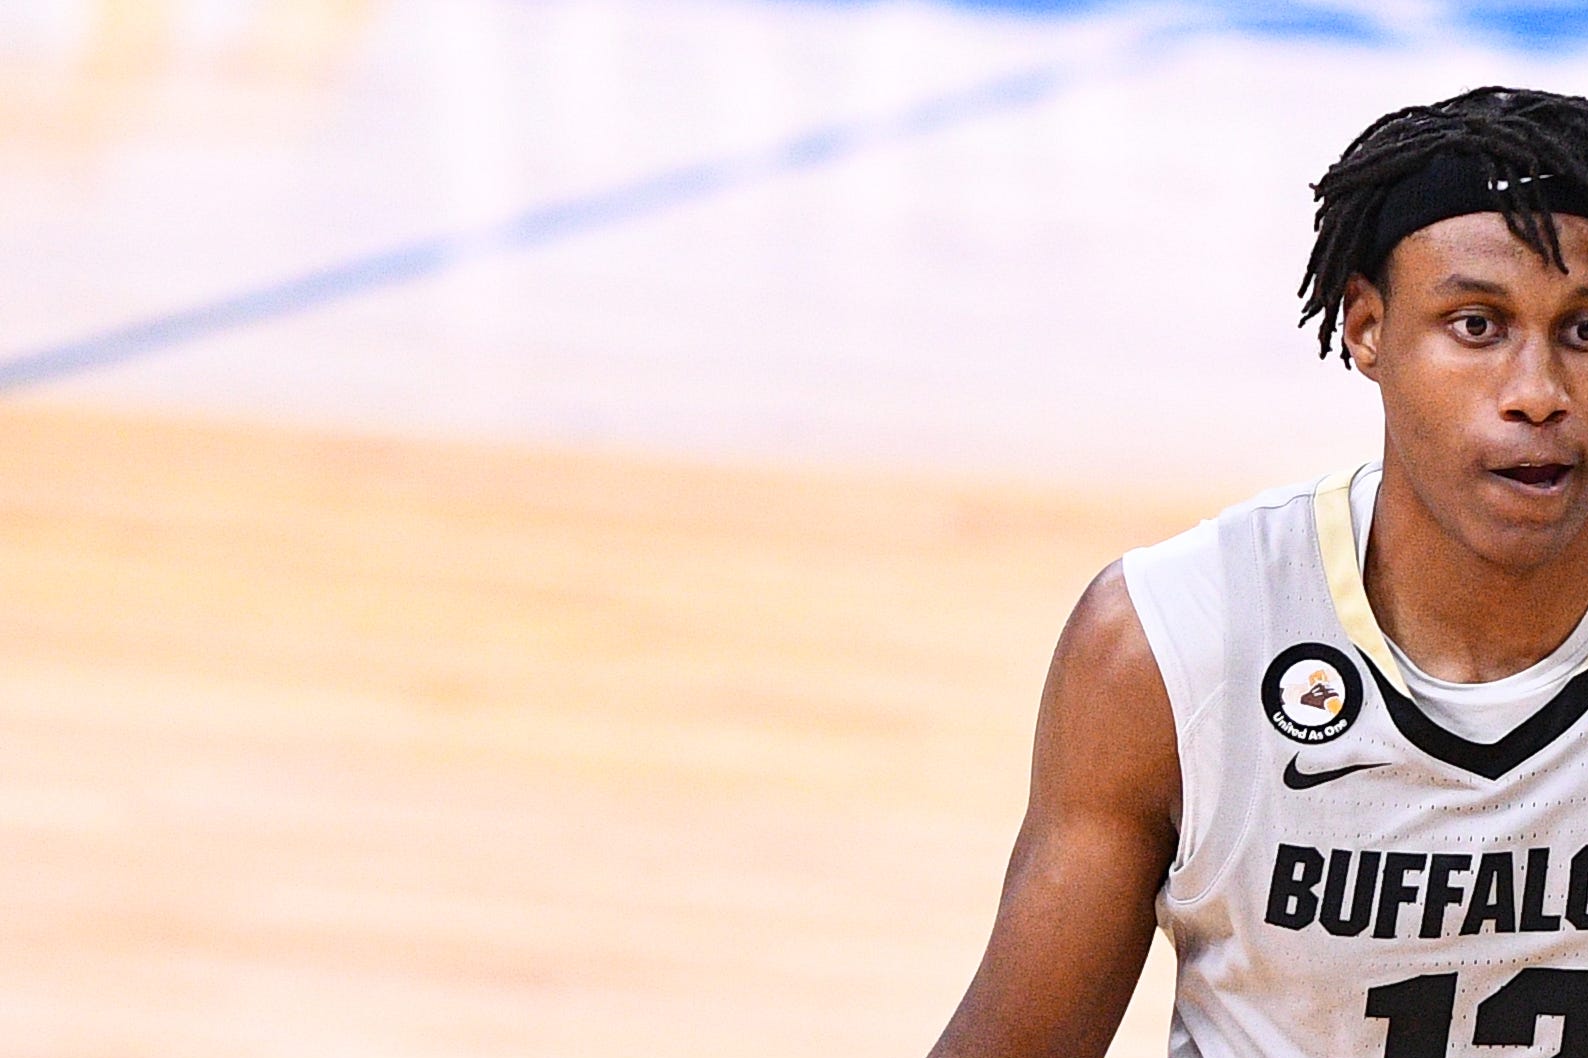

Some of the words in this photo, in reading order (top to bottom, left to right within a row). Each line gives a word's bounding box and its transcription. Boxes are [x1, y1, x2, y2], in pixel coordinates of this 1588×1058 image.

[1272, 711, 1308, 740] United
[1308, 730, 1324, 741] As
[1324, 718, 1348, 737] One
